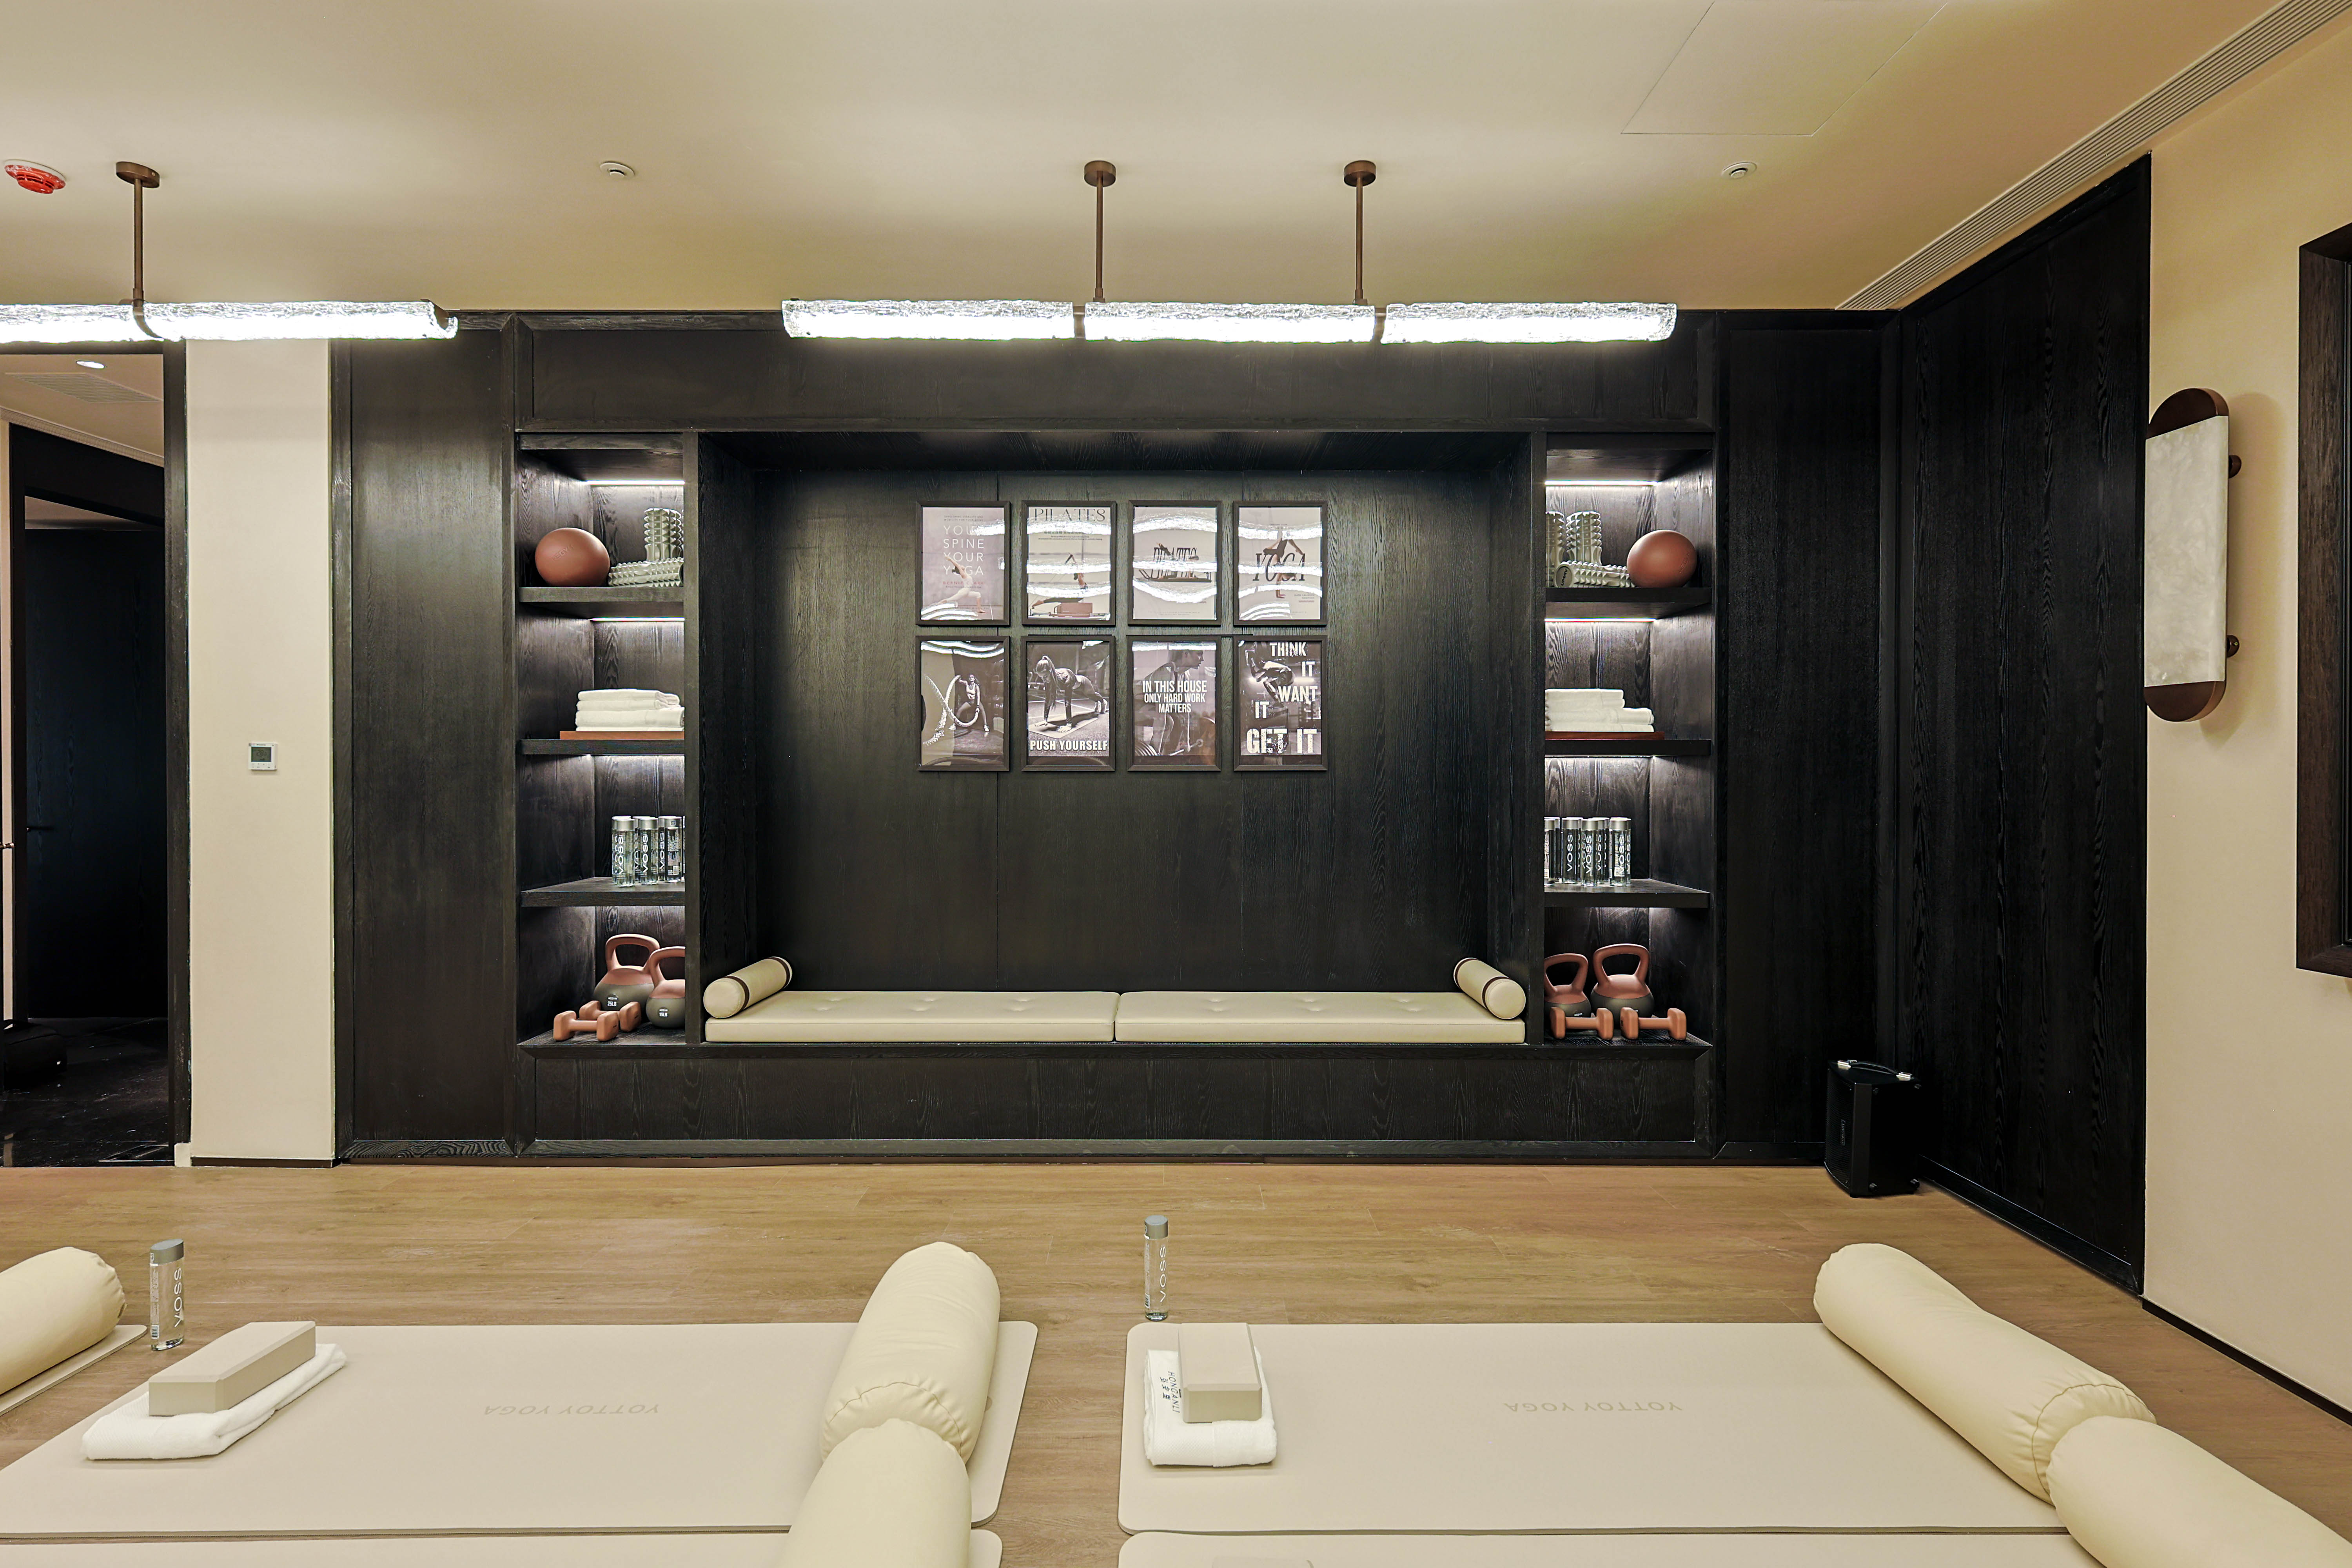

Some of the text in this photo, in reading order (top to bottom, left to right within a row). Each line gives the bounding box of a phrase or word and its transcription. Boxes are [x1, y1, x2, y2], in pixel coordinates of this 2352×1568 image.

[1034, 508, 1105, 522] PILATES
[944, 525, 977, 535] YOU
[943, 539, 984, 549] SPINE
[943, 552, 984, 562] YOUR
[943, 565, 984, 575] YGA
[1269, 642, 1307, 657] THINK
[1301, 661, 1315, 677] IT
[1142, 680, 1207, 693] IN THIS HOUSE
[1144, 693, 1206, 703] ONLY HARD WORK
[1278, 686, 1318, 702] WANT
[1158, 703, 1192, 713] MATTERS
[1254, 701, 1269, 719] IT
[1029, 740, 1108, 751] PUSH YOURSELF
[1246, 728, 1318, 754] GET IT
[174, 1268, 182, 1327] VOSS
[1168, 1371, 1180, 1413] HONGANLI
[484, 1404, 659, 1416] YOTTOY YOGA
[1503, 1402, 1682, 1412] YOTTOY YOGA
